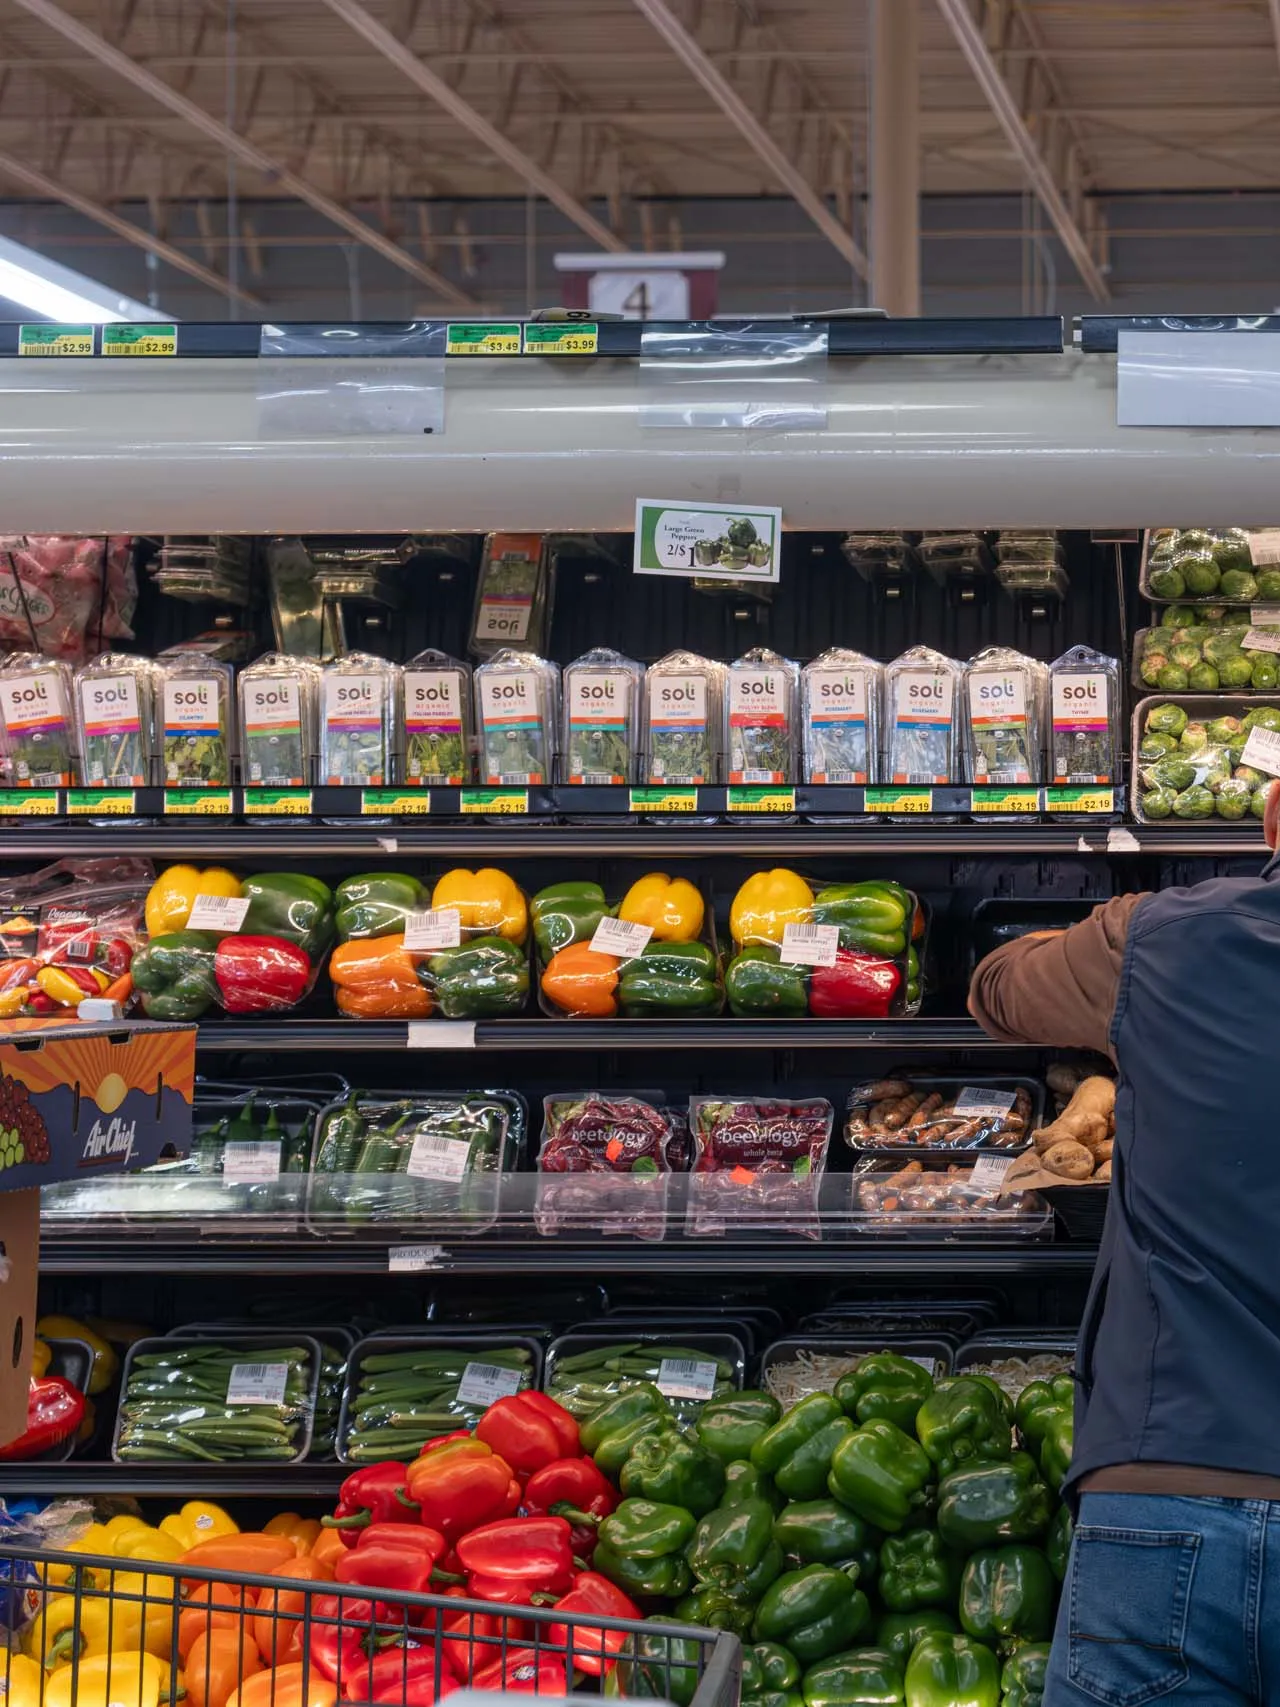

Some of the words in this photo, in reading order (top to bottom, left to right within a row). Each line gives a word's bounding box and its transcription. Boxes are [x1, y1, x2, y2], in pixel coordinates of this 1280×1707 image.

[621, 280, 651, 320] 4
[62, 343, 91, 354] $2.99
[145, 343, 174, 354] $2.99
[489, 342, 518, 352] $3.49
[566, 340, 594, 350] $3.99
[12, 680, 47, 704] soli
[94, 681, 128, 703] soli
[338, 681, 371, 701] soli
[416, 681, 449, 701] soli
[492, 678, 526, 699] soli
[580, 679, 614, 700] soli
[662, 681, 695, 701] soli
[741, 676, 775, 695] soli
[821, 676, 855, 696] soli
[909, 680, 943, 699] soli
[980, 678, 1014, 698] soli
[1063, 680, 1097, 699] soli
[174, 684, 208, 705] soli
[256, 684, 289, 705] soli
[30, 805, 55, 814] $2.19
[106, 804, 132, 814] $2.19
[203, 804, 229, 814] $2.19
[284, 805, 309, 814] $2.19
[401, 804, 427, 813] $2.19
[500, 803, 526, 813] $2.19
[668, 801, 694, 811] $2.19
[767, 802, 792, 811] $2.19
[903, 802, 929, 811] $2.19
[1011, 801, 1036, 811] $2.19
[1084, 800, 1110, 809] $2.19
